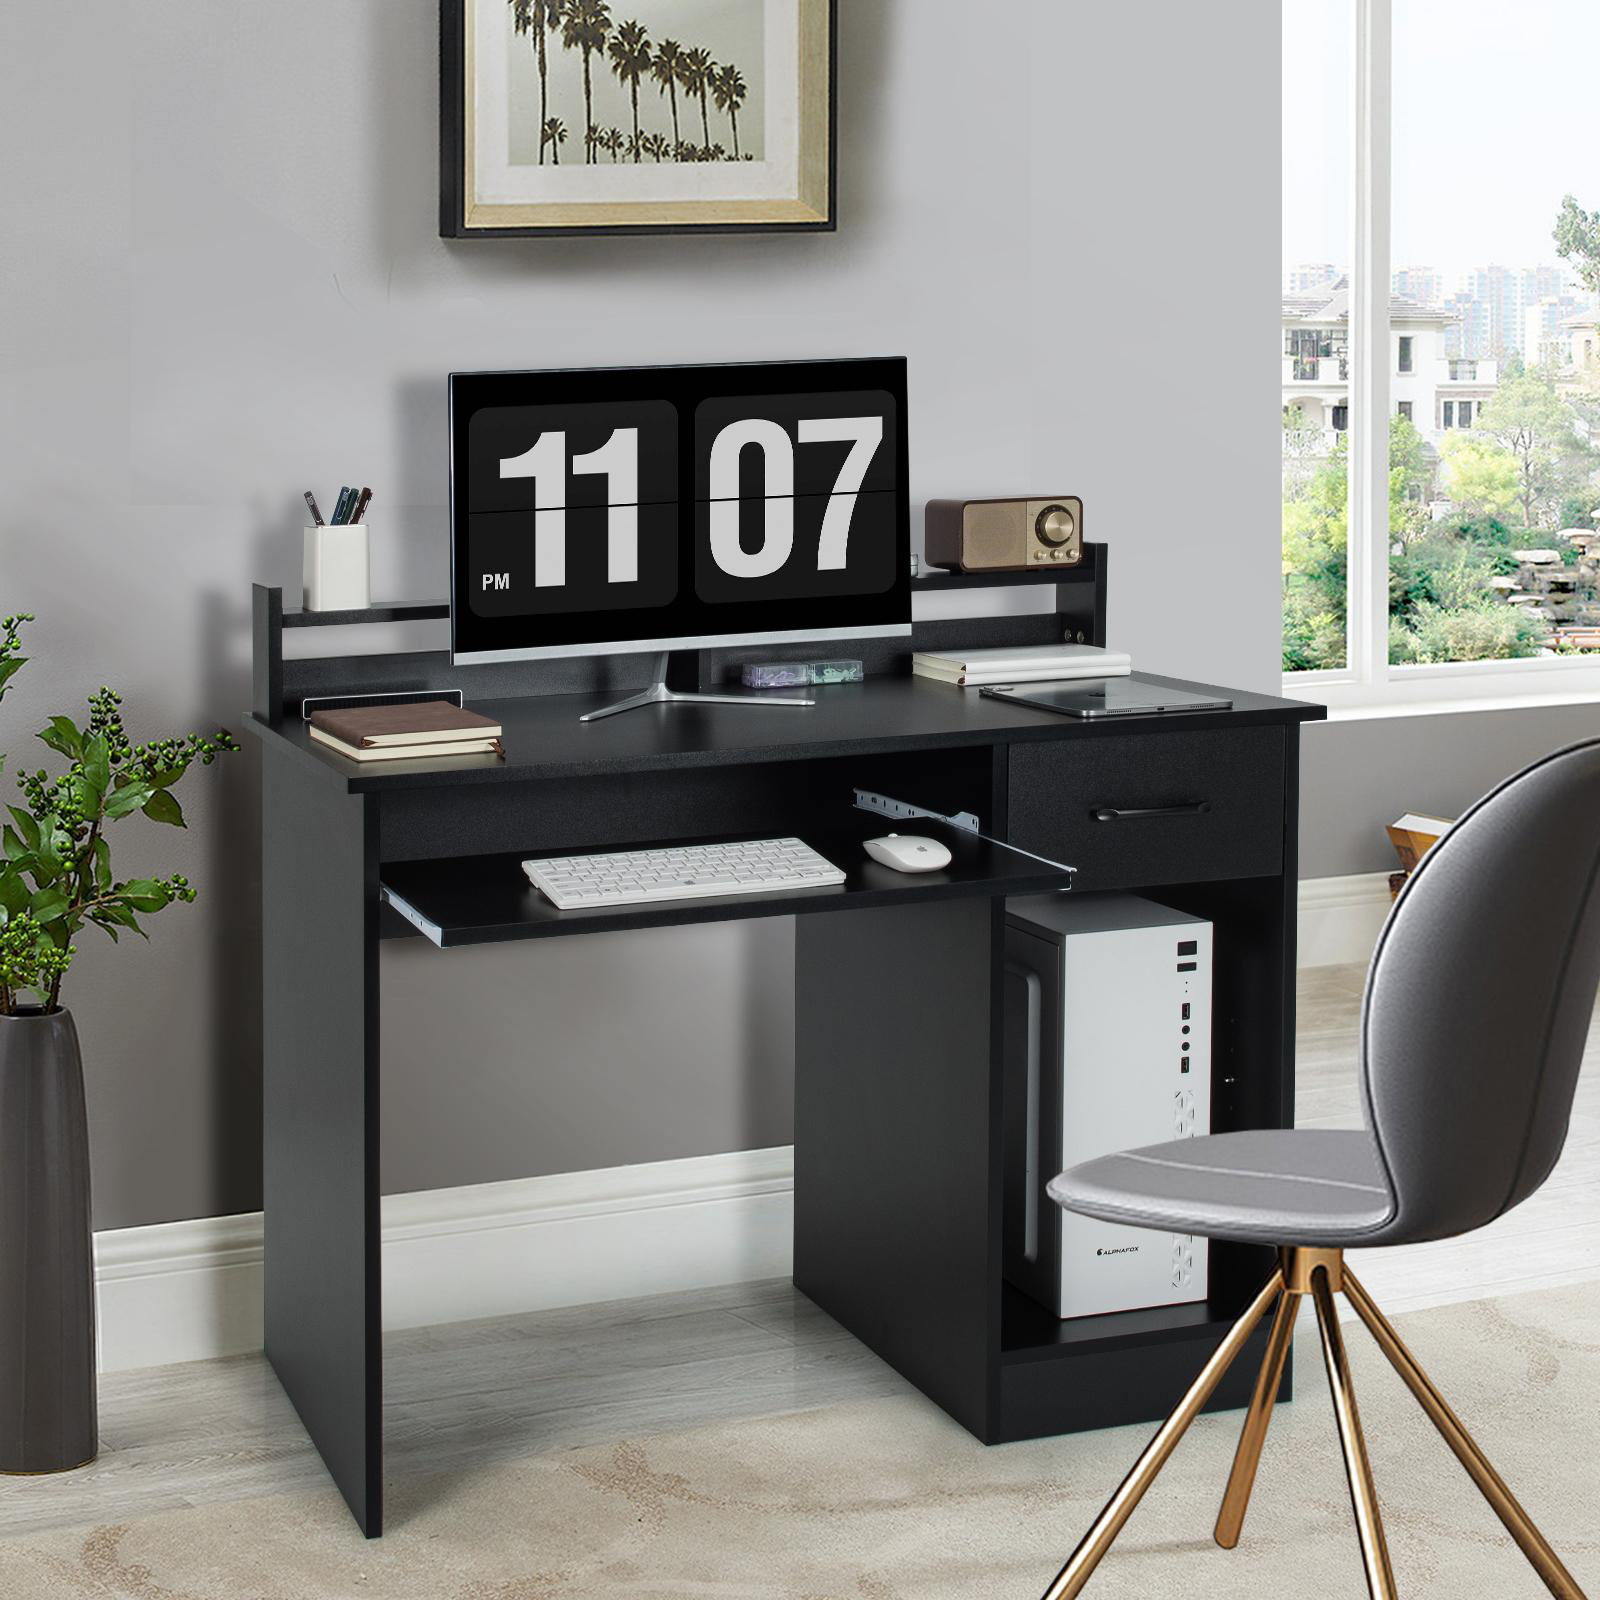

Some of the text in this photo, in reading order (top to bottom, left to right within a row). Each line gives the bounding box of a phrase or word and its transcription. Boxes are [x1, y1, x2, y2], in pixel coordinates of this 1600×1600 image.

[499, 415, 884, 588] 11 07
[482, 573, 510, 591] PM
[1103, 1246, 1139, 1256] ALPHAFOX
